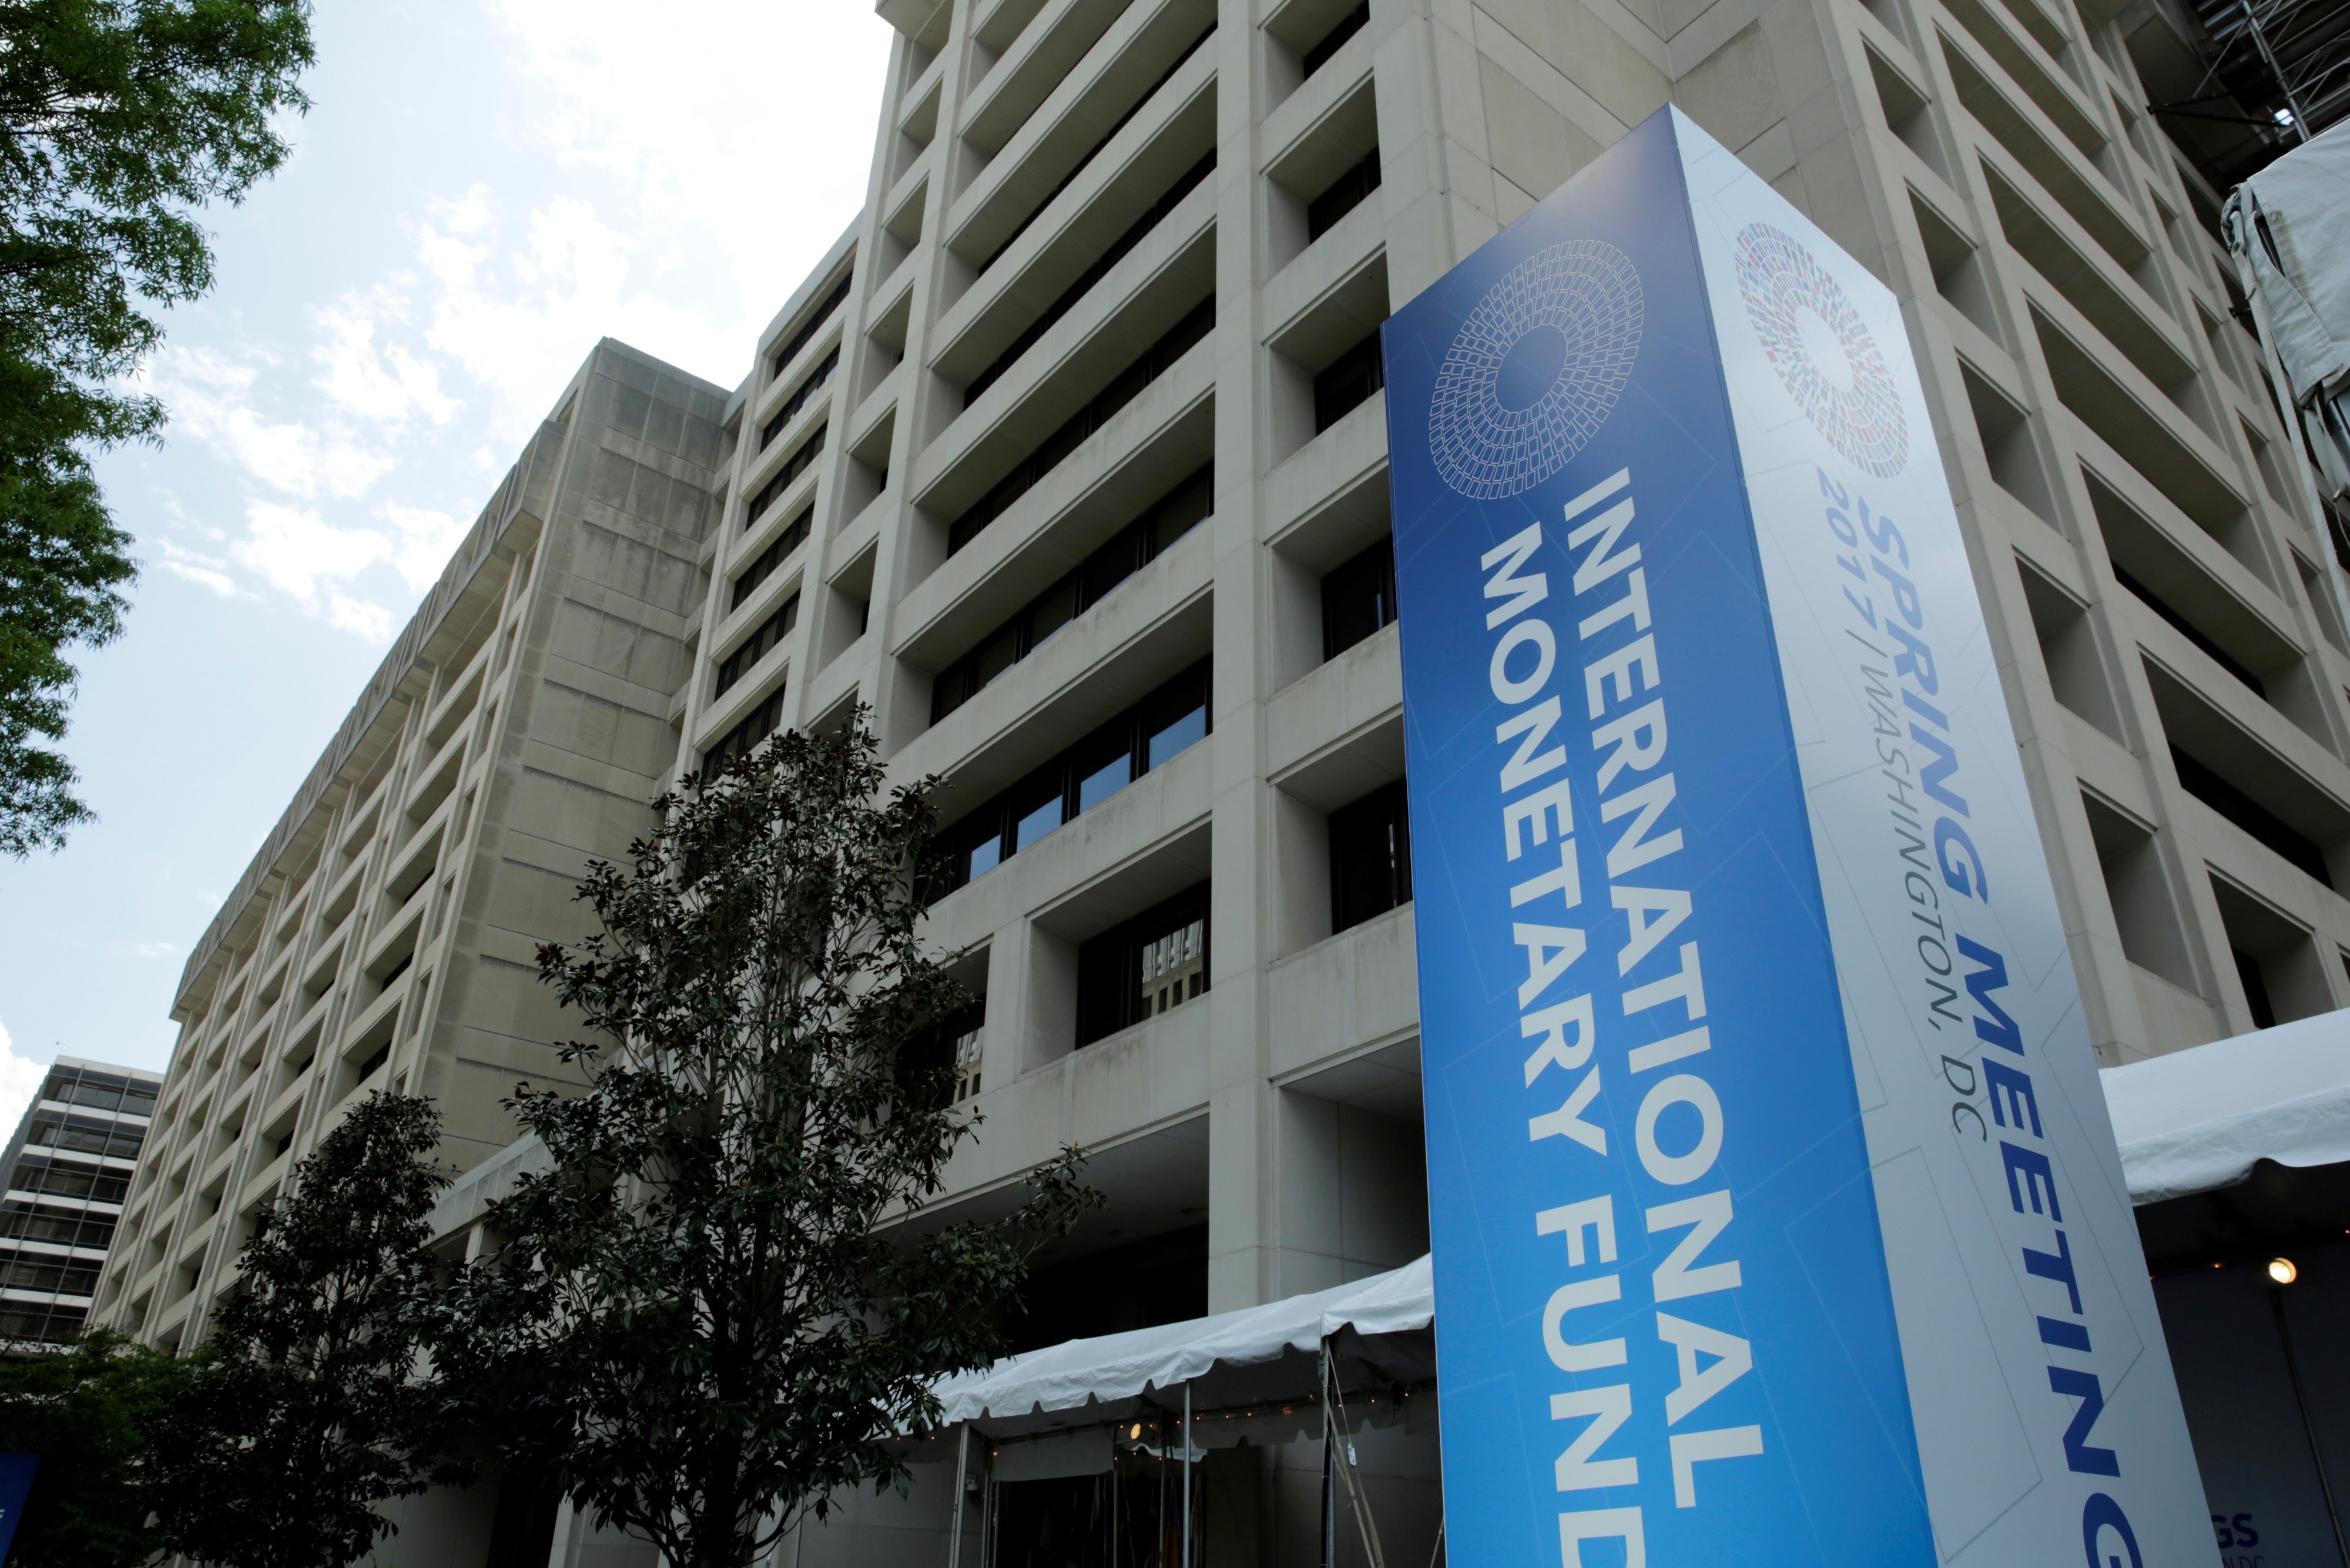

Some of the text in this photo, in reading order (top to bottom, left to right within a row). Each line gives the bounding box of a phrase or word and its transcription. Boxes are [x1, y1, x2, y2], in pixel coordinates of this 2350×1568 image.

[1481, 521, 1645, 1568] MONETARY FUND
[1564, 467, 1764, 1508] INTERNATIONAL
[1816, 465, 1877, 631] 2017
[1859, 664, 1963, 1031] WASHINGTON,
[1941, 1054, 1987, 1142] DC
[1858, 496, 1987, 904] SPRING
